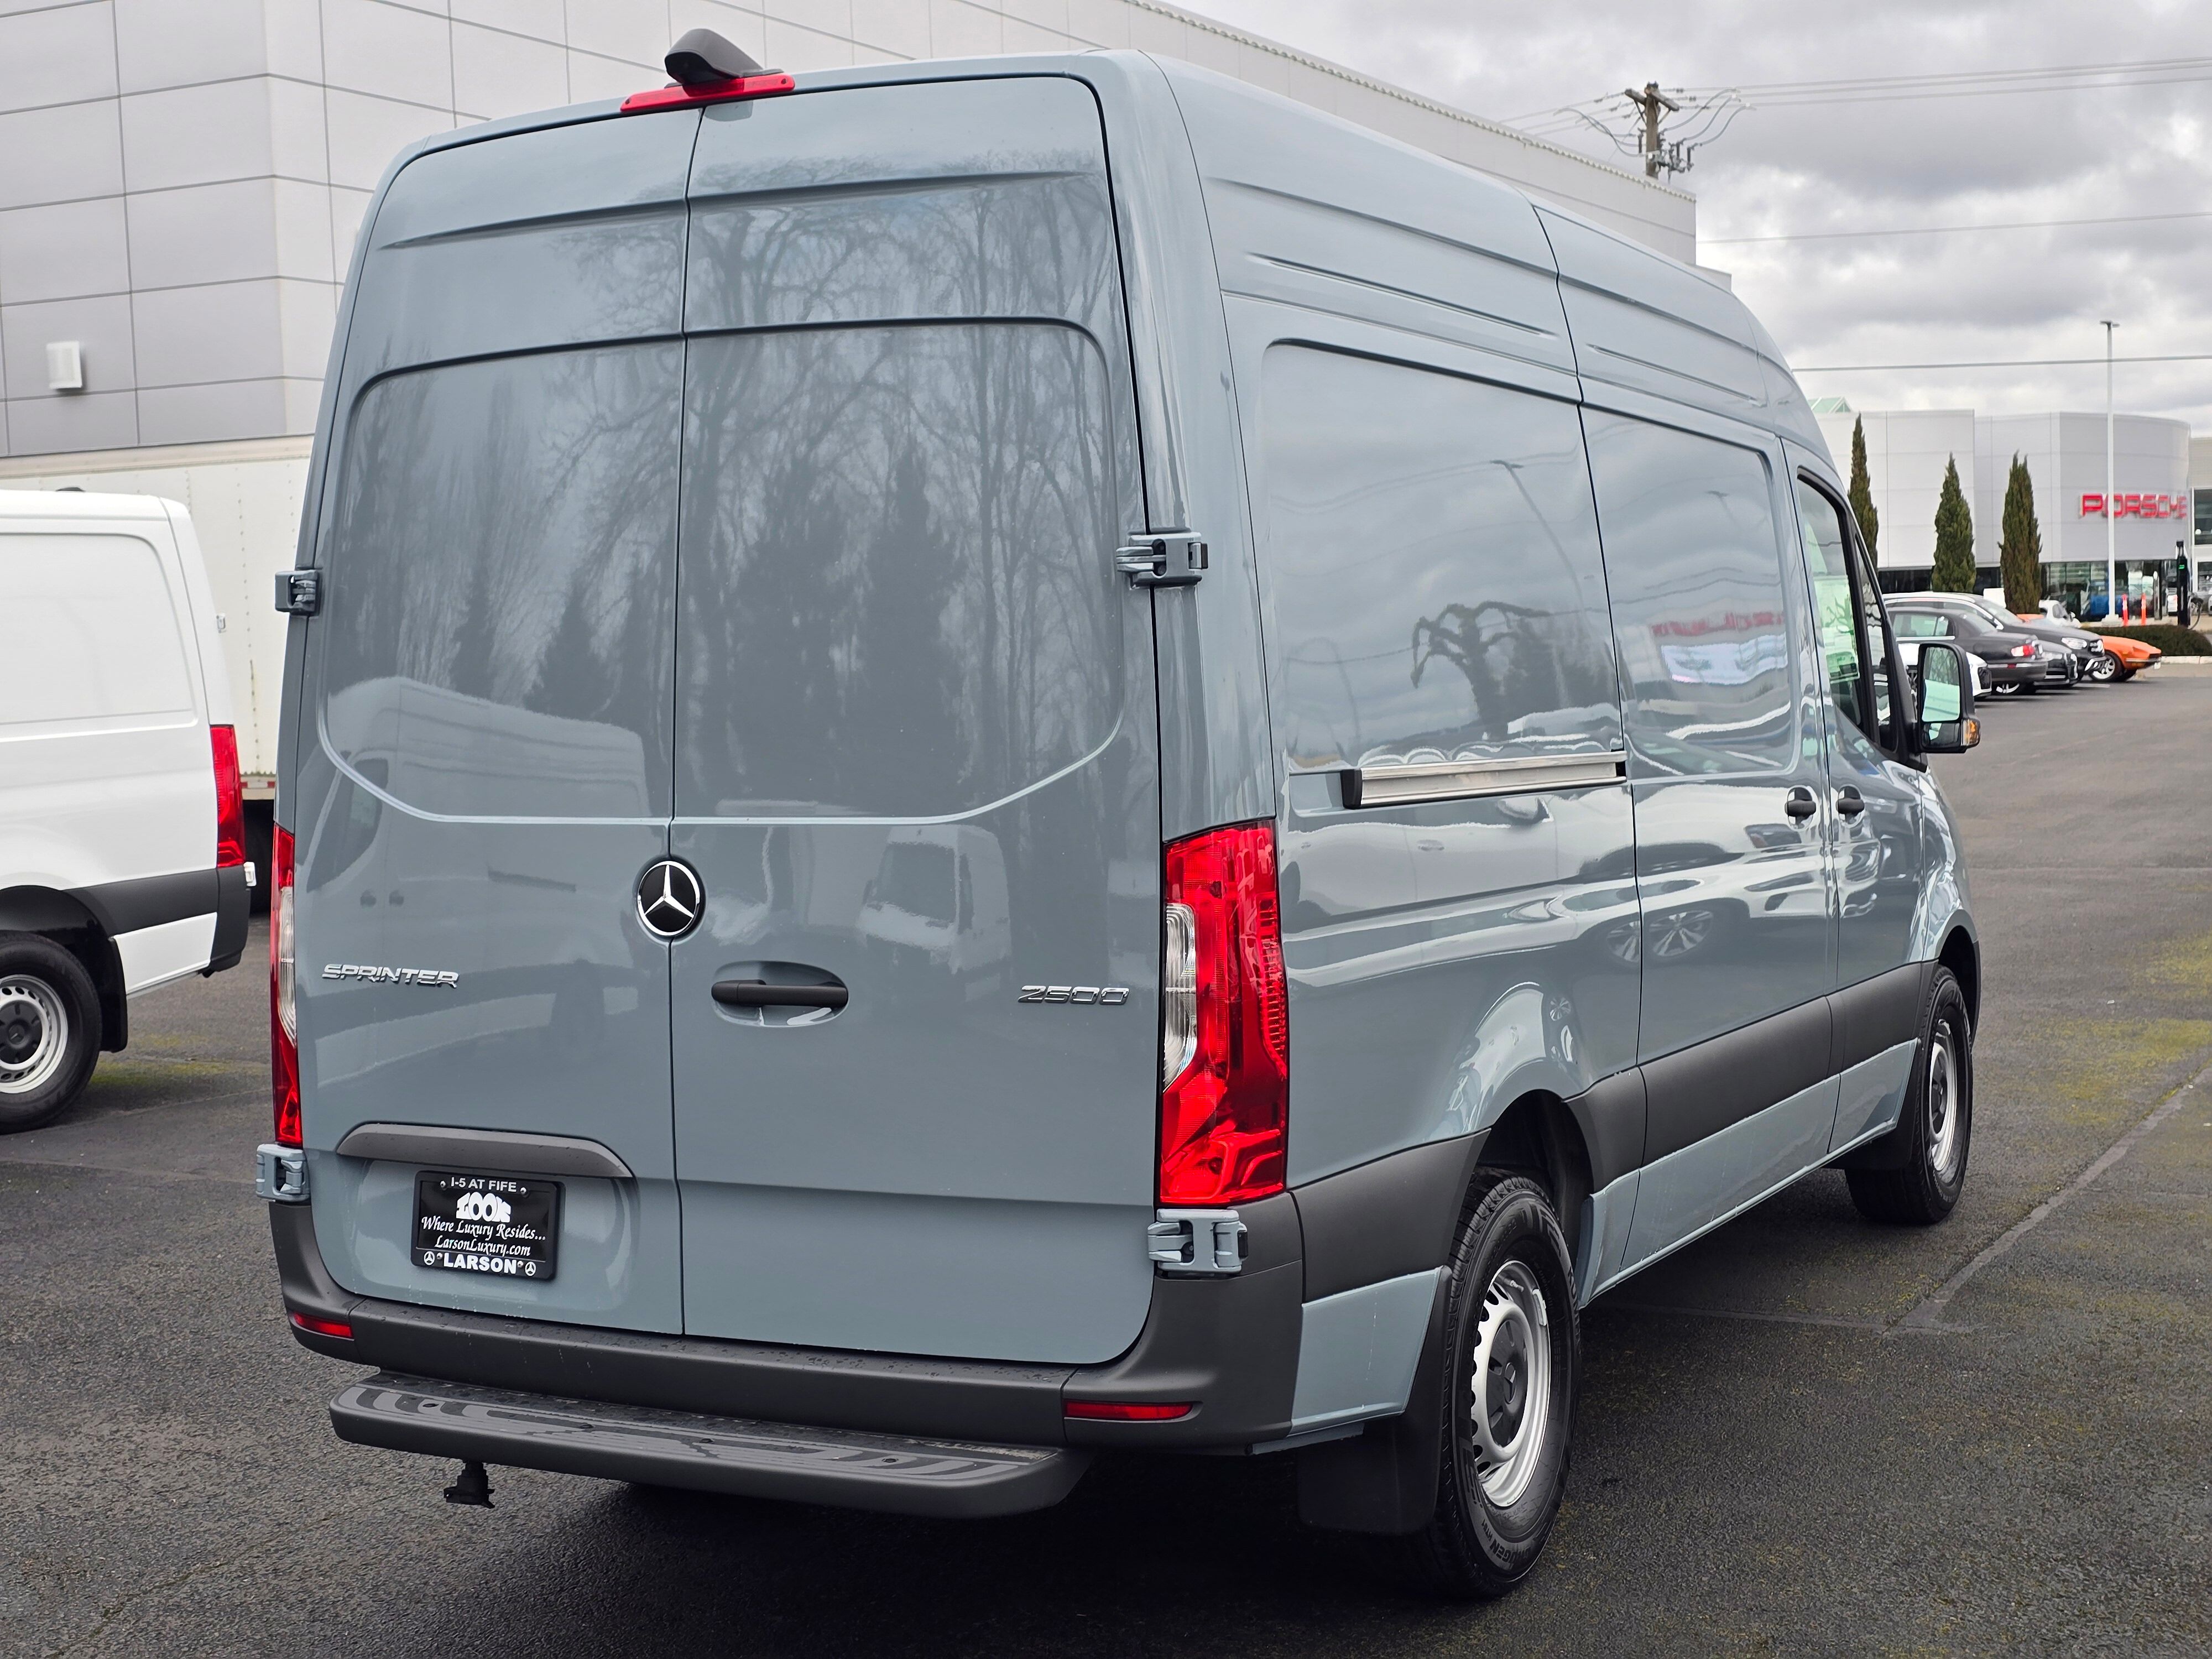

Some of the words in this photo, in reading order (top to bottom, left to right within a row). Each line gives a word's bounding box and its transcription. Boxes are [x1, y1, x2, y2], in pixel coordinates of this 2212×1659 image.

[2081, 493, 2187, 519] PORSCHE
[322, 964, 458, 988] SPRINTER
[1018, 985, 1129, 1004] 2500
[451, 1177, 466, 1187] I-5
[468, 1179, 485, 1189] AT
[488, 1181, 517, 1192] FIFE
[421, 1215, 453, 1232] Where
[456, 1220, 493, 1240] Luxury
[496, 1224, 546, 1240] Resides...
[435, 1235, 531, 1257] LarsonLuxury.com
[444, 1253, 517, 1274] LARSON
